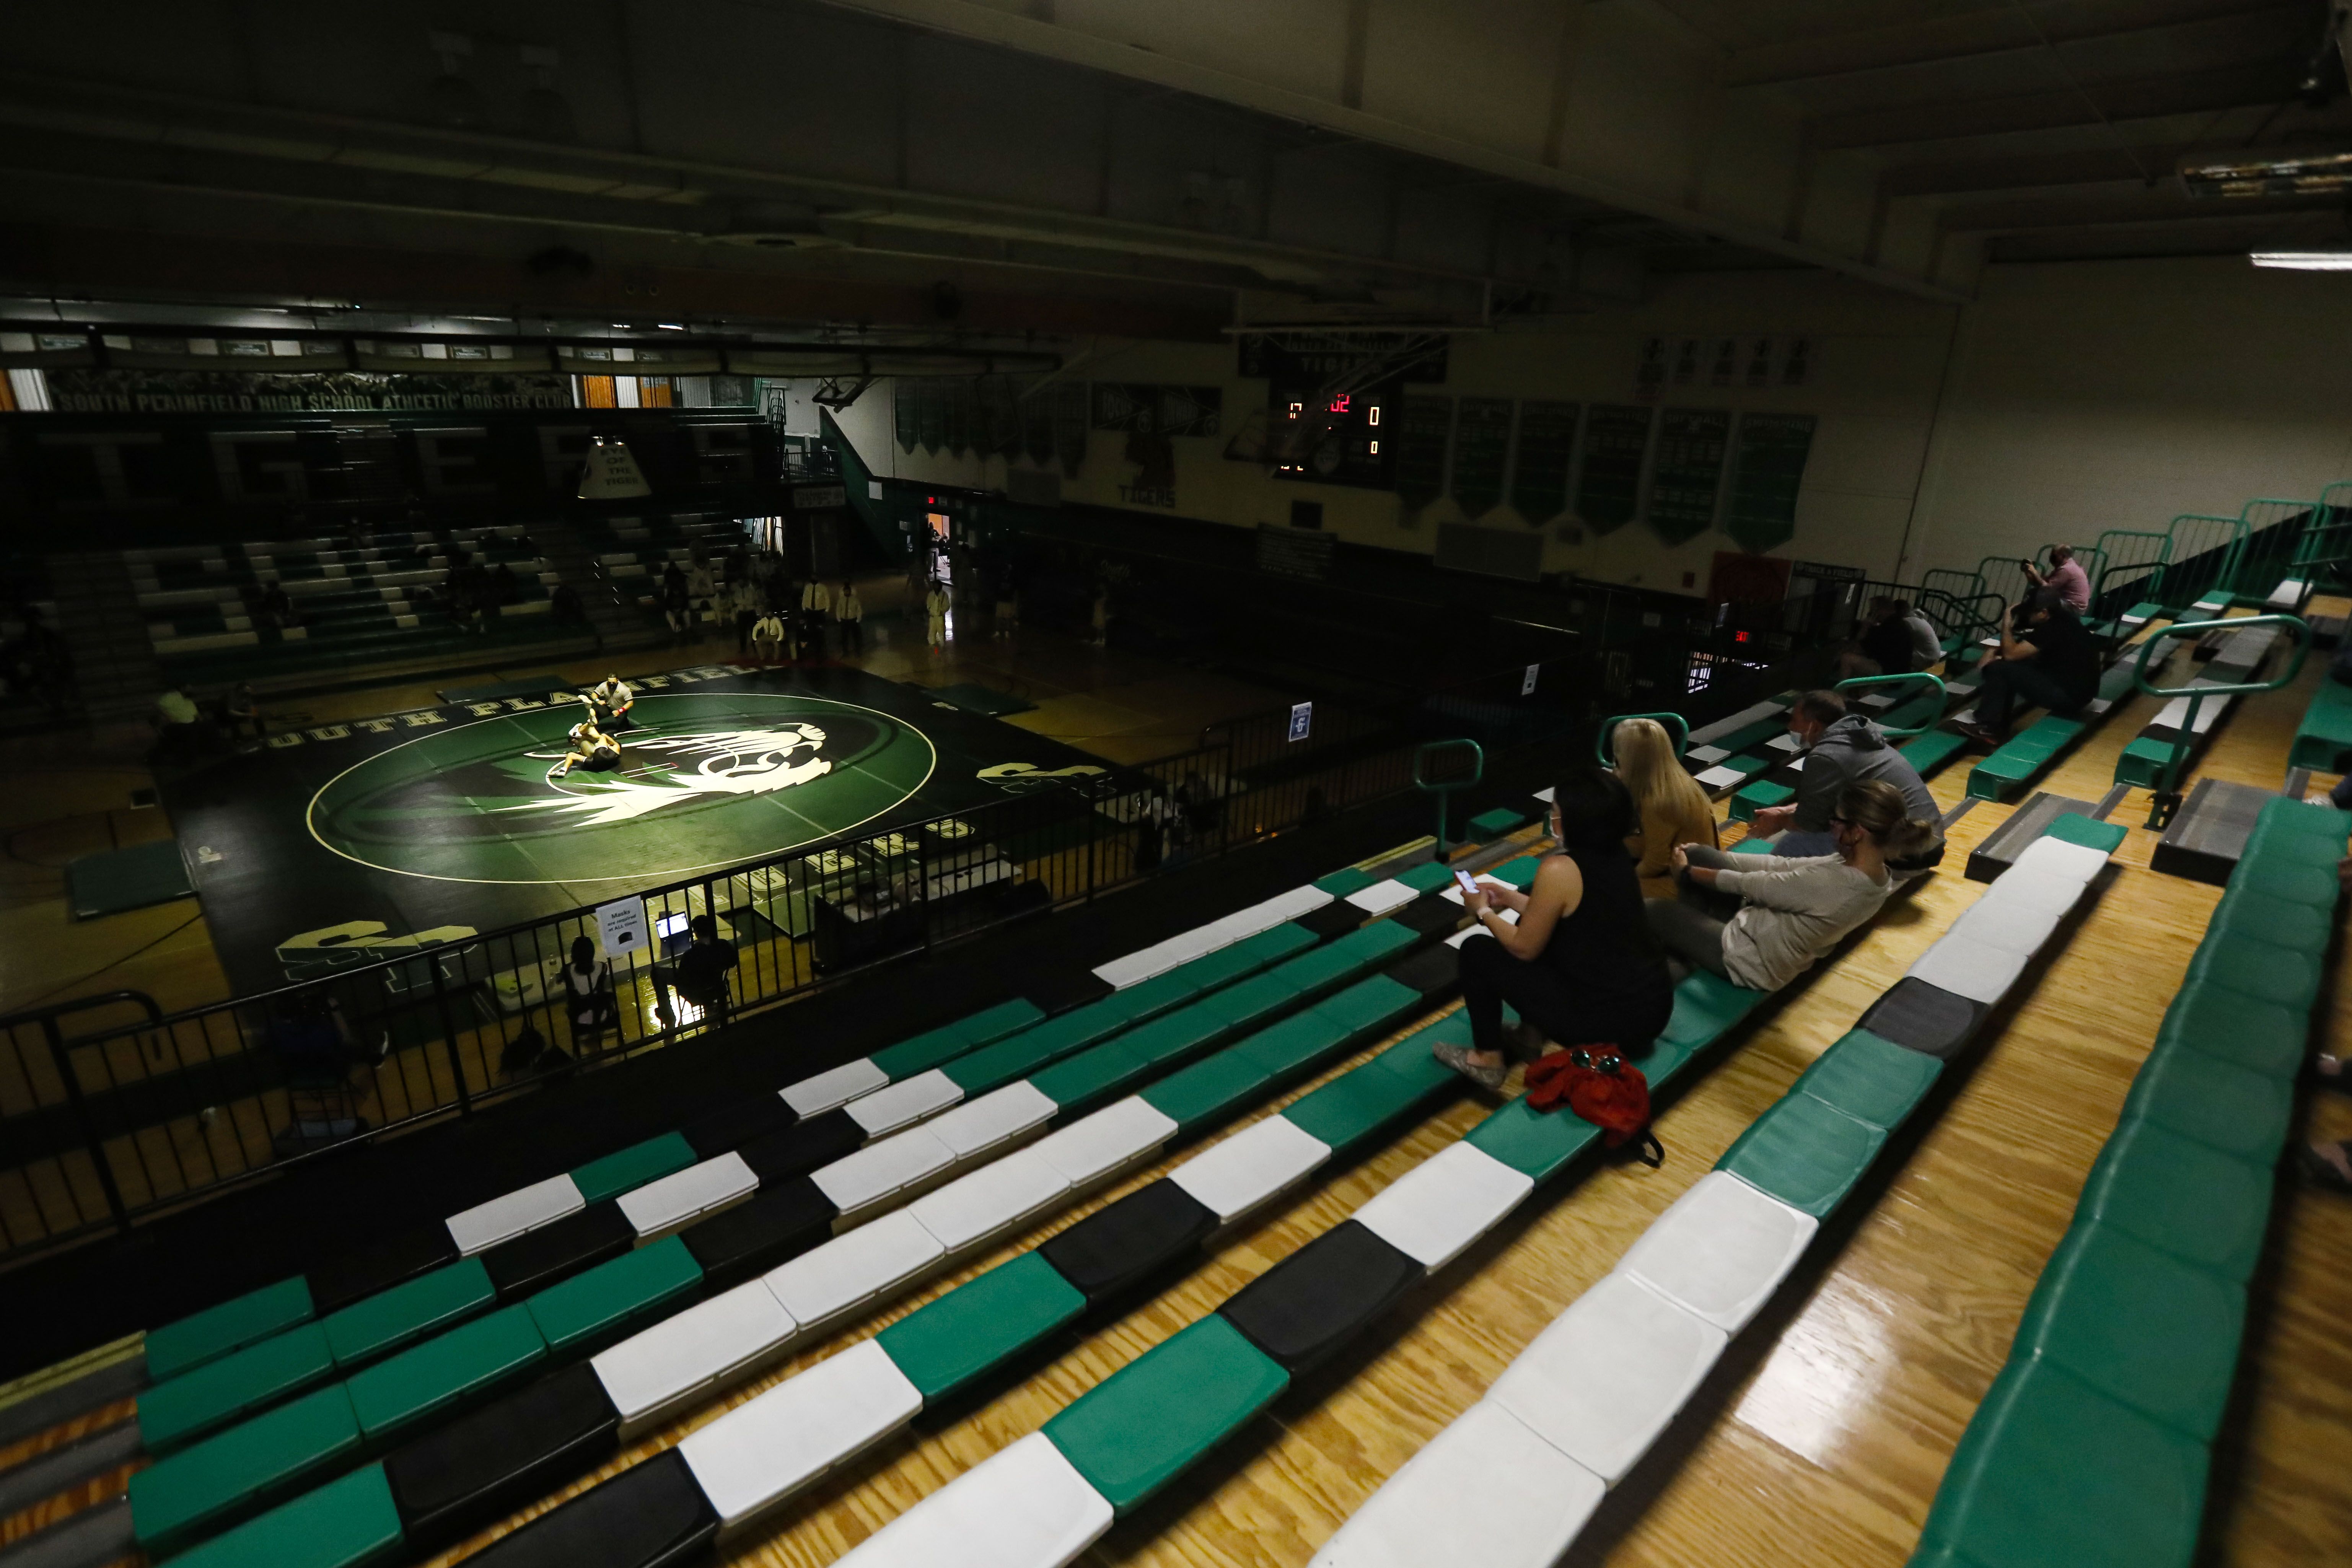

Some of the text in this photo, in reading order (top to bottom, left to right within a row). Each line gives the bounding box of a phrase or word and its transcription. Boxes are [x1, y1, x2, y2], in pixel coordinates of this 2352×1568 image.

[59, 394, 572, 412] SOUTH PLAINFIELD HIGH SCHOOL ATHLETIC BOOSTER CLUB
[601, 448, 626, 456] EYE
[609, 466, 632, 475] THE
[605, 477, 638, 486] TIGER
[1118, 485, 1176, 508] TIGERS
[611, 909, 630, 919] Masks
[616, 913, 636, 924] required
